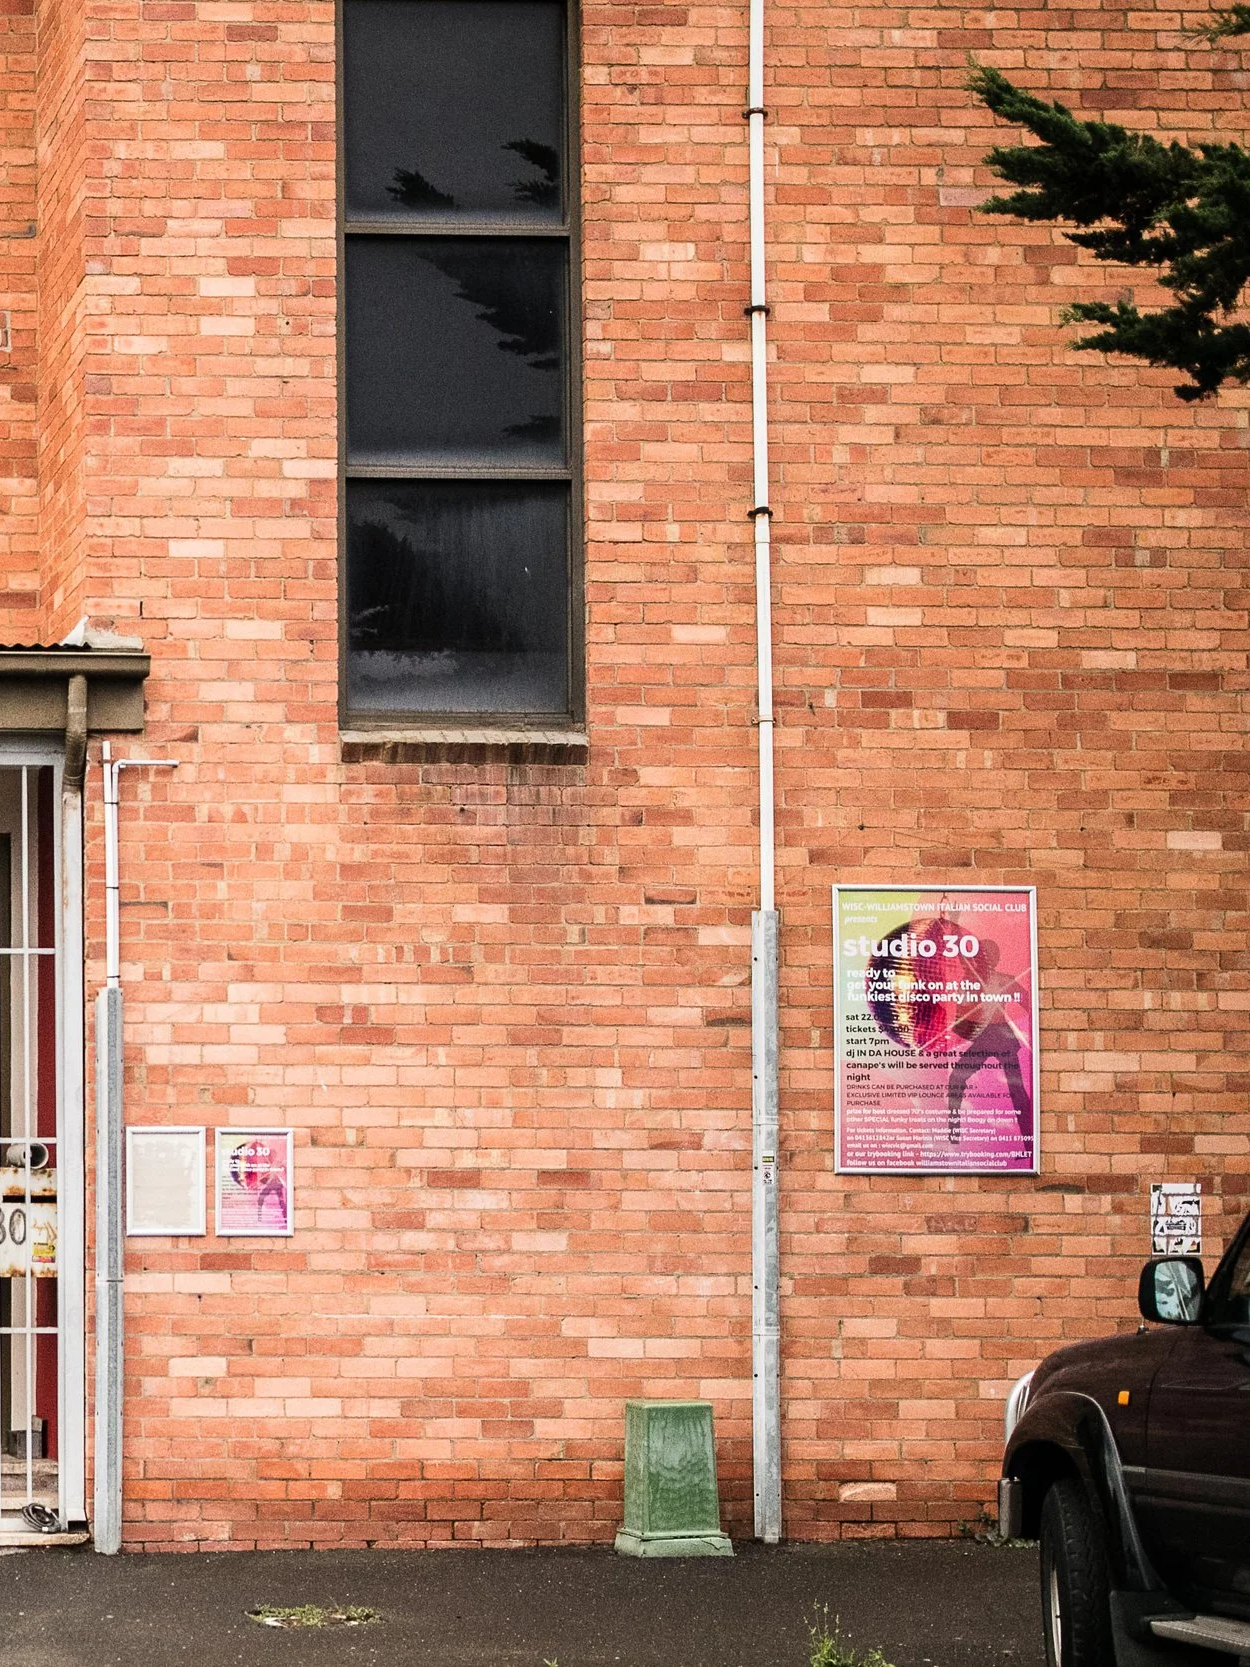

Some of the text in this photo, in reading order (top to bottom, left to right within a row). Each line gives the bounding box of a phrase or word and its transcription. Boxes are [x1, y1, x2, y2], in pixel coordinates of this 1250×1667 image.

[937, 903, 970, 912] ITALIAN
[972, 903, 1002, 912] SOCIAL
[1005, 903, 1027, 912] CLUB
[843, 933, 980, 958] studio 30
[846, 968, 896, 980] ready to
[945, 981, 959, 990] at
[960, 980, 981, 990] the
[846, 991, 896, 1002] funkiest
[899, 992, 930, 1002] disco
[932, 992, 965, 1004] party
[967, 992, 978, 1002] in
[980, 993, 1012, 1002] town
[869, 1038, 889, 1046] 7pm
[846, 1049, 855, 1058] dj
[933, 1050, 956, 1058] great
[888, 1061, 904, 1070] will
[906, 1061, 917, 1070] be
[919, 1061, 948, 1070] served
[951, 1061, 1002, 1070] throughout
[846, 1073, 870, 1082] night
